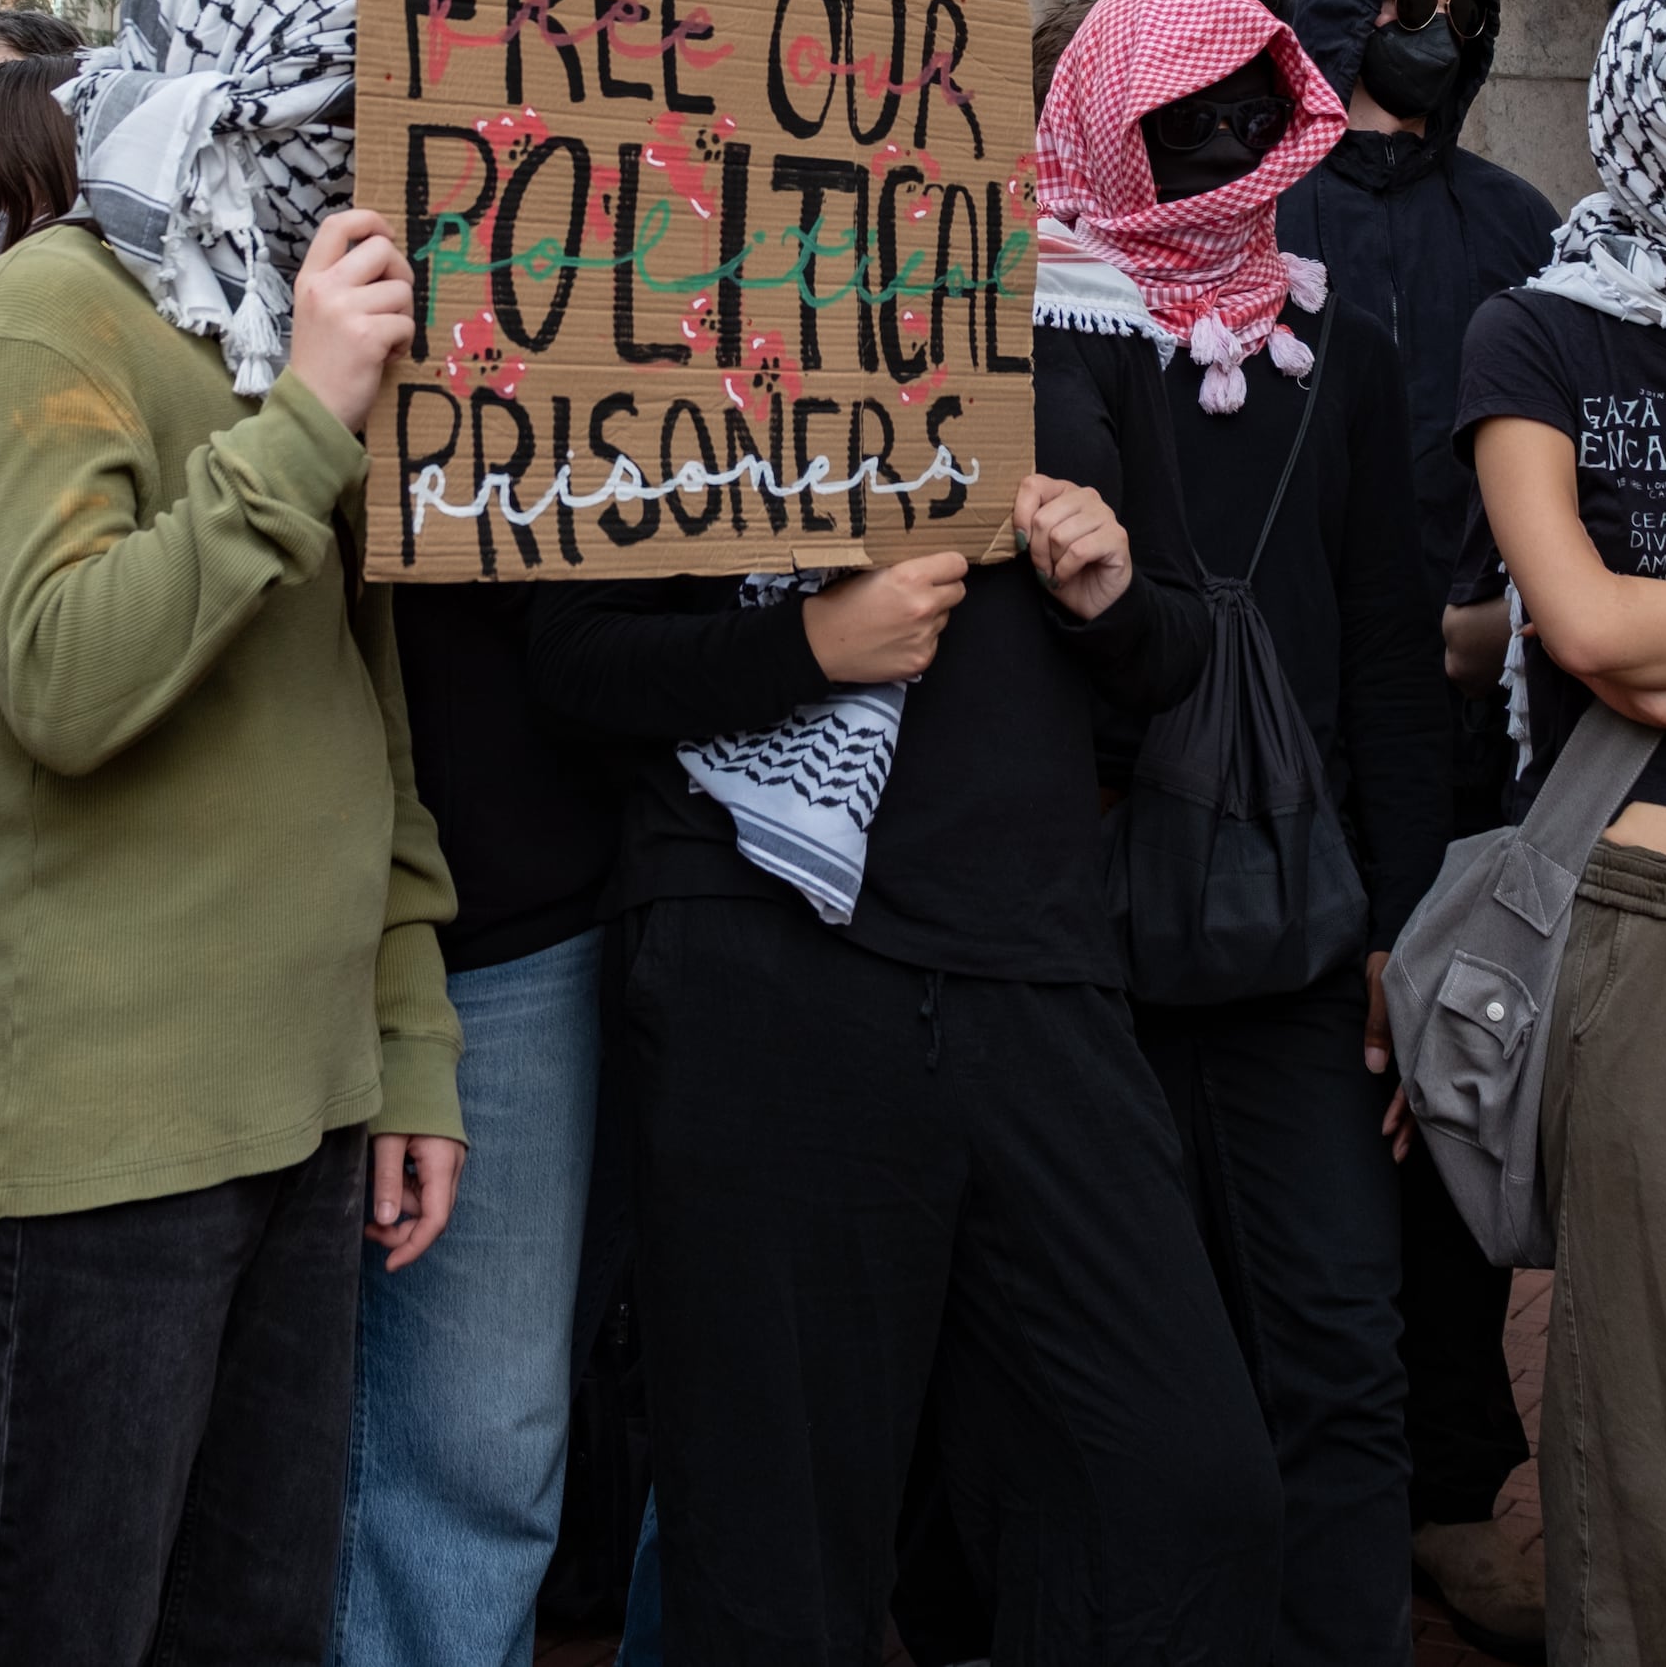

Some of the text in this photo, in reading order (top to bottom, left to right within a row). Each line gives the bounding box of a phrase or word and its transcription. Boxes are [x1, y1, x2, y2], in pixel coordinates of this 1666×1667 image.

[785, 35, 976, 106] our
[405, 123, 1034, 384] POLITICAL
[1583, 394, 1661, 429] GAZA
[397, 382, 970, 578] PRISONERS
[410, 445, 979, 534] prisoners
